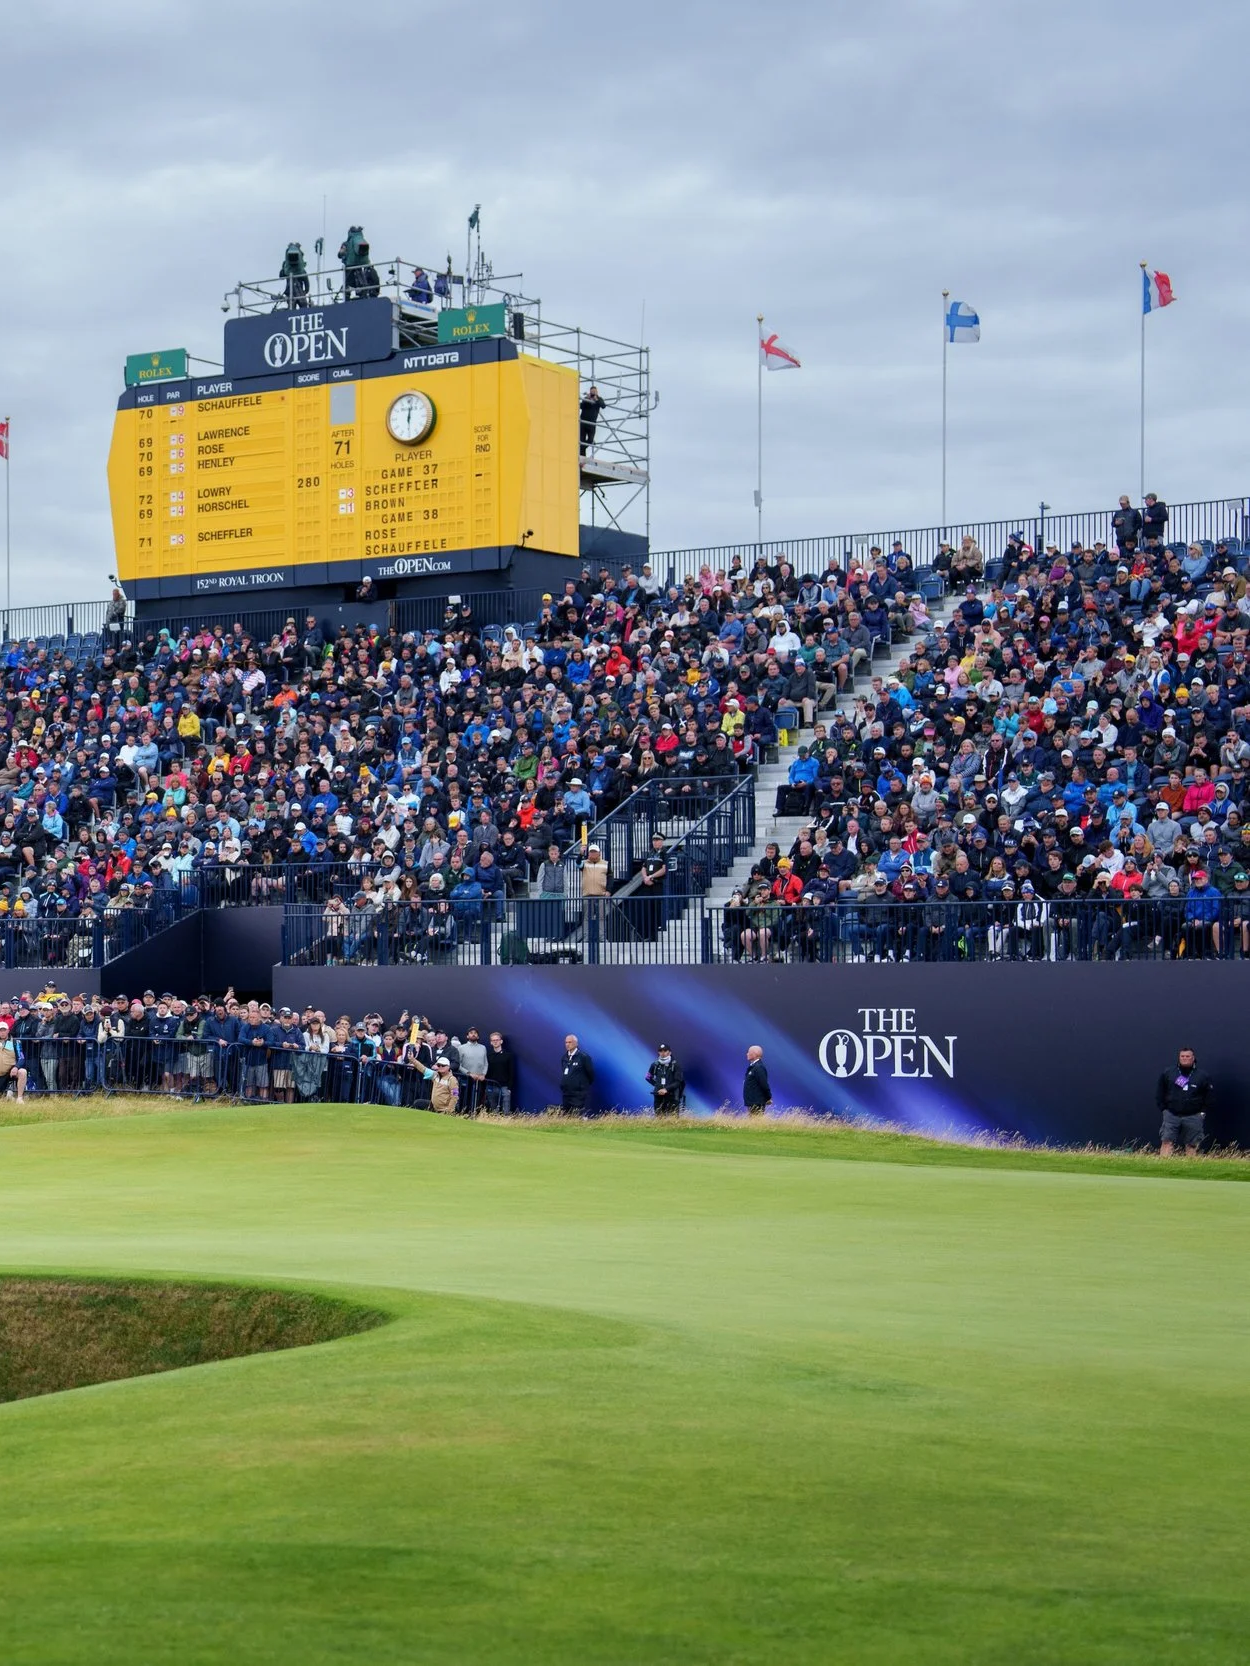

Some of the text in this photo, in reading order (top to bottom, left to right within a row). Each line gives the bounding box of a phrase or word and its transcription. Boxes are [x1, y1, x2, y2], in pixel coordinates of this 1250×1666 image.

[288, 312, 324, 334] THE
[453, 323, 490, 336] ROLEX
[264, 327, 348, 368] OPEN
[138, 366, 172, 379] ROLEX
[138, 394, 154, 403] HOLE
[166, 391, 180, 399] PAR
[197, 382, 232, 395] PLAYER
[298, 373, 320, 383] SCORE
[139, 409, 153, 420] 70
[197, 395, 262, 412] SCHAUFFELE
[331, 429, 354, 438] AFTER
[474, 424, 492, 432] SCORE
[139, 437, 153, 448] 69
[197, 426, 250, 441] LAWRENCE
[477, 434, 489, 442] FOR
[139, 451, 153, 462] 70
[197, 444, 224, 455] ROSE
[334, 440, 351, 455] 71
[475, 444, 491, 453] RND
[395, 450, 432, 462] PLAYER
[139, 466, 153, 477] 69
[197, 457, 235, 469] HENLEY
[331, 460, 354, 469] HOLES
[381, 464, 439, 479] GAME 37
[297, 476, 320, 488] 280
[365, 479, 438, 496] SCHEFFLER
[139, 495, 153, 505] 72
[197, 486, 232, 499] LOWRY
[139, 509, 153, 519] 69
[197, 499, 250, 513] HORSCHEL
[365, 497, 405, 511] BROWN
[381, 509, 439, 524] GAME 38
[139, 537, 152, 547] 71
[197, 528, 253, 542] SCHEFFLER
[365, 528, 396, 541] ROSE
[365, 538, 447, 556] SCHAUFFELE
[219, 575, 248, 587] ROYAL
[249, 572, 285, 584] TROON
[857, 1008, 917, 1033] THE
[818, 1029, 958, 1078] OPEN
